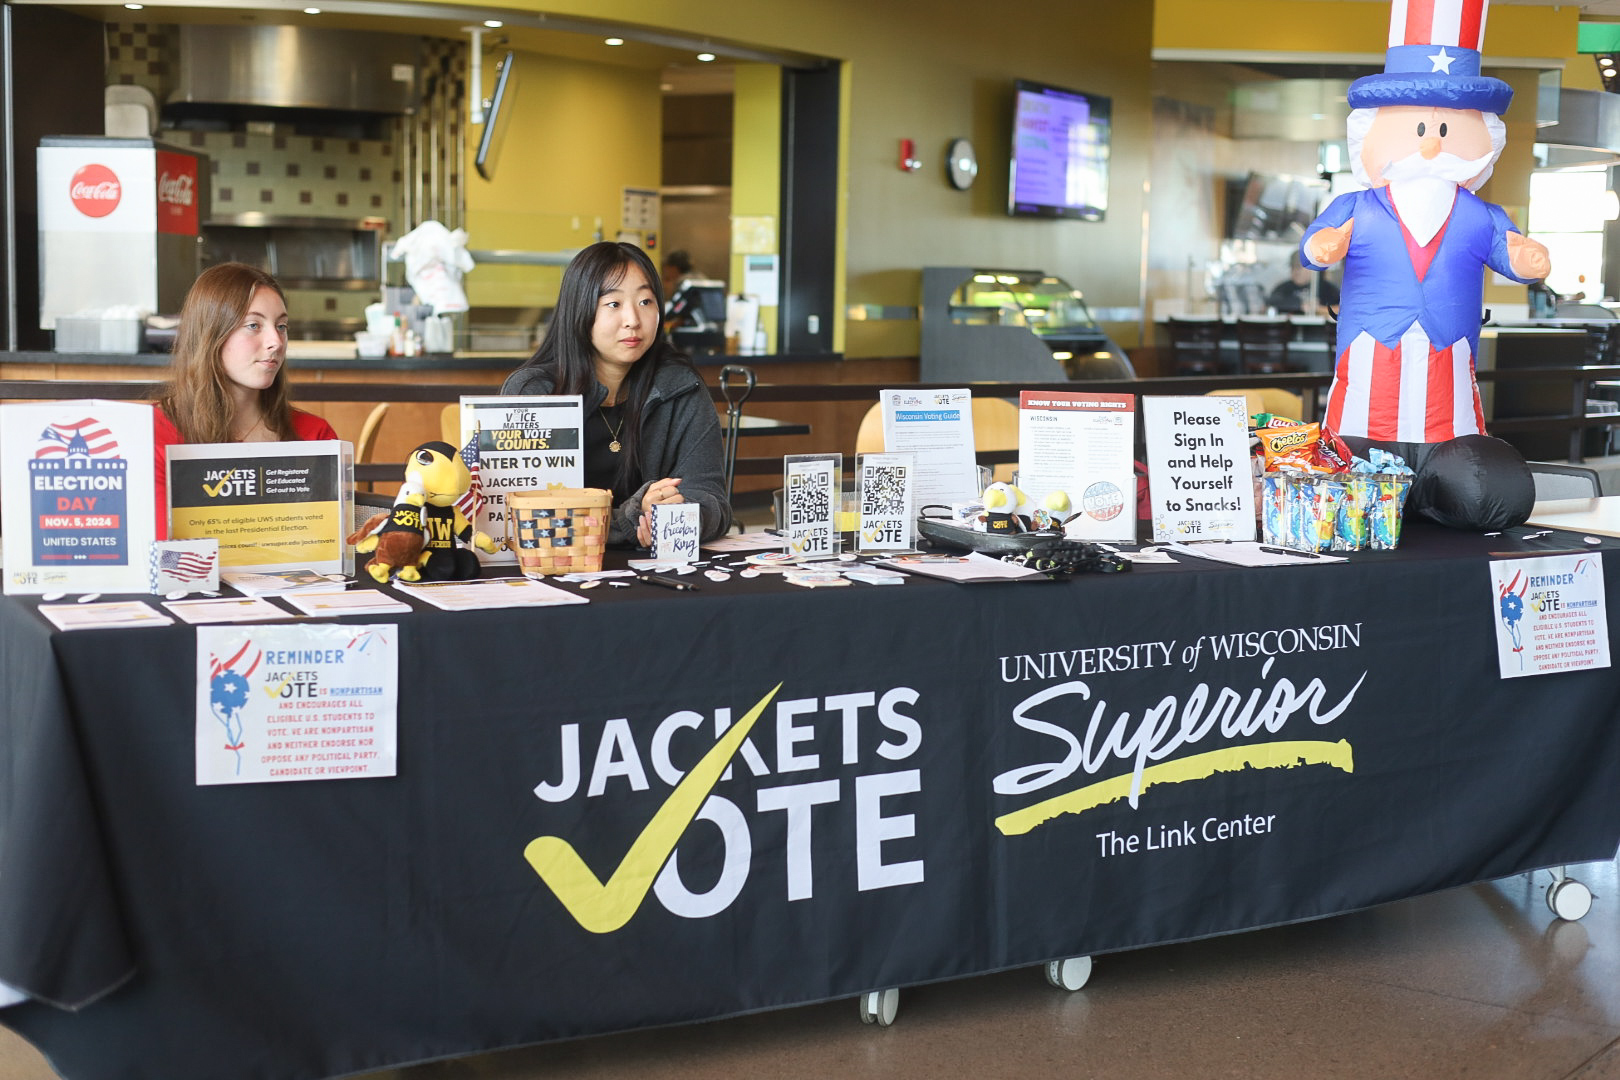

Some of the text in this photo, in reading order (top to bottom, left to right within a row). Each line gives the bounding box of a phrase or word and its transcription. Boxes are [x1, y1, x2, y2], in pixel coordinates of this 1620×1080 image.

[1174, 411, 1221, 425] Please
[491, 429, 552, 439] YOUR VOTE
[496, 439, 549, 450] COUNTS.
[1174, 433, 1223, 450] Sign In
[1271, 432, 1308, 453] Cheetos
[480, 456, 575, 469] NTER TO WIN
[1168, 454, 1233, 471] and Help
[204, 469, 256, 480] JACKETS
[35, 476, 122, 490] ELECTION
[487, 477, 537, 487] JACKETS
[1171, 476, 1233, 490] Yourself
[57, 497, 98, 510] DAY
[1166, 497, 1241, 511] to Snacks!
[45, 518, 112, 527] NOV. 5, 2024
[189, 519, 205, 527] Only
[231, 517, 255, 526] eligible
[671, 511, 685, 525] Let
[240, 525, 279, 533] Presidential
[864, 520, 902, 528] JACKETS
[792, 527, 828, 539] JACKETS
[43, 537, 116, 546] UNITED STATES
[673, 538, 698, 557] Ring
[1530, 574, 1574, 587] REMINDER
[1531, 591, 1560, 600] JACKETS
[1567, 600, 1597, 608] NONPARTISAN
[266, 650, 344, 665] REMINDER
[999, 622, 1362, 683] UNIVERSITY of WISCONSIN
[265, 671, 318, 682] JACKETS
[330, 687, 383, 695] NONPARTISAN
[296, 701, 346, 709] ENCOURAGES
[267, 715, 303, 723] ELIGIBLE
[323, 713, 362, 721] STUDENTS
[304, 727, 319, 735] ARE
[322, 726, 373, 734] NONPARTISAN
[993, 656, 1368, 810] Superior
[285, 740, 318, 748] NEITHER
[321, 739, 356, 747] ENDORSE
[533, 687, 922, 802] JACKETS
[261, 755, 292, 763] OPPOSE
[312, 753, 351, 761] POLITICAL
[270, 767, 312, 776] CANDIDATE
[1096, 814, 1275, 857] The Link Center
